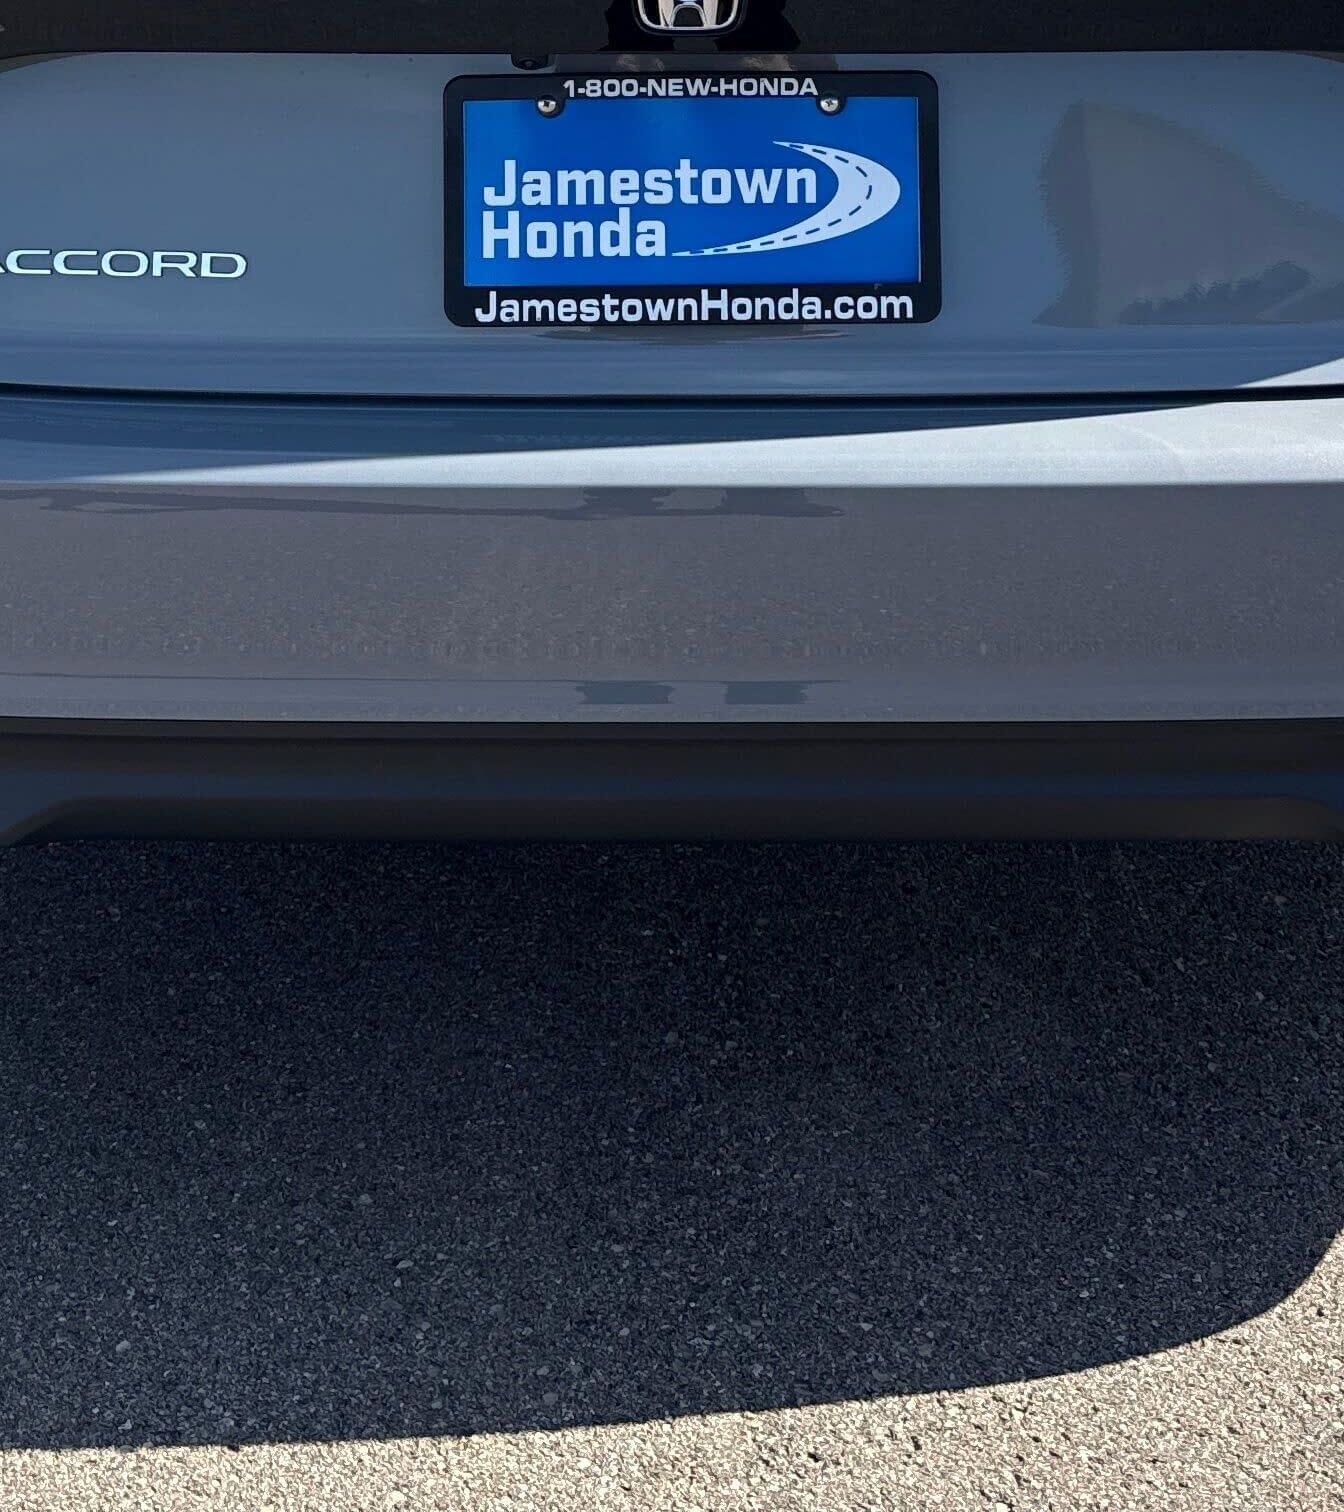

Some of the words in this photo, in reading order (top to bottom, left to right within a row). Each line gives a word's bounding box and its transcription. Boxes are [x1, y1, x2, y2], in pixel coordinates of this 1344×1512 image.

[563, 77, 818, 97] 1-800-NEW-HONDA
[484, 159, 817, 206] Jamestown
[482, 207, 667, 259] Honda
[475, 289, 914, 323] JamestownHonda.com
